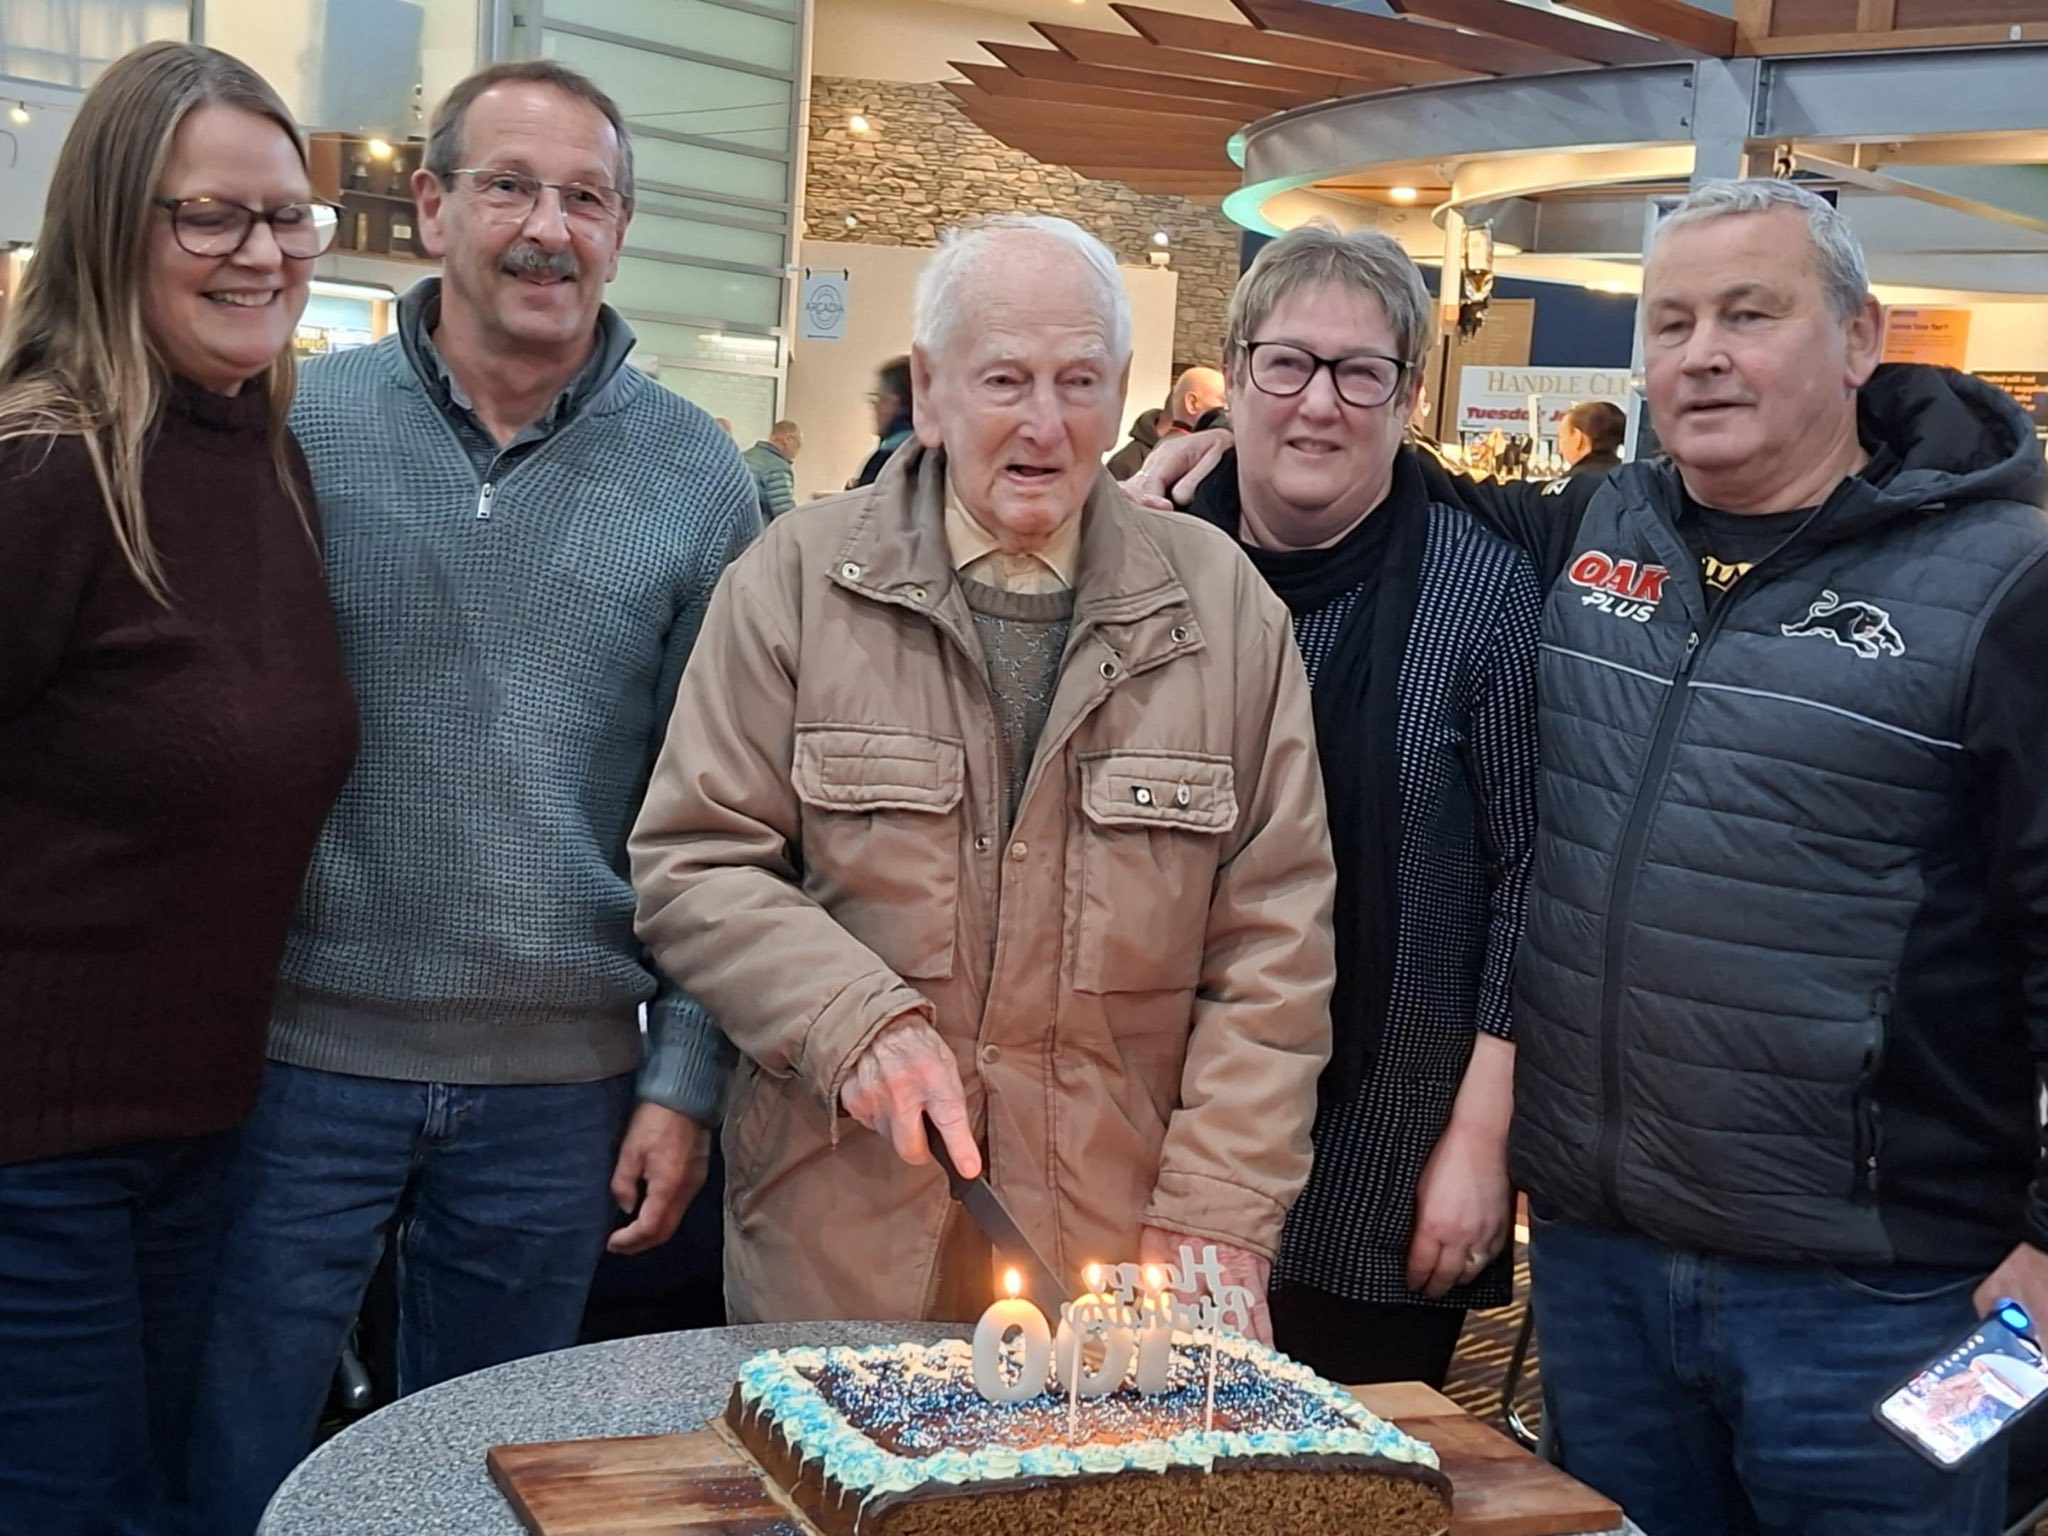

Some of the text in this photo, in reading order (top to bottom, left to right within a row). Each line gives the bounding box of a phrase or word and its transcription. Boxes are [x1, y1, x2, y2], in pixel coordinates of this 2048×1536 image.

[1487, 370, 1632, 396] HANDLE CLU
[1466, 406, 1546, 421] Tuesda
[1569, 550, 1670, 604] OAK
[1581, 592, 1655, 623] PLUS
